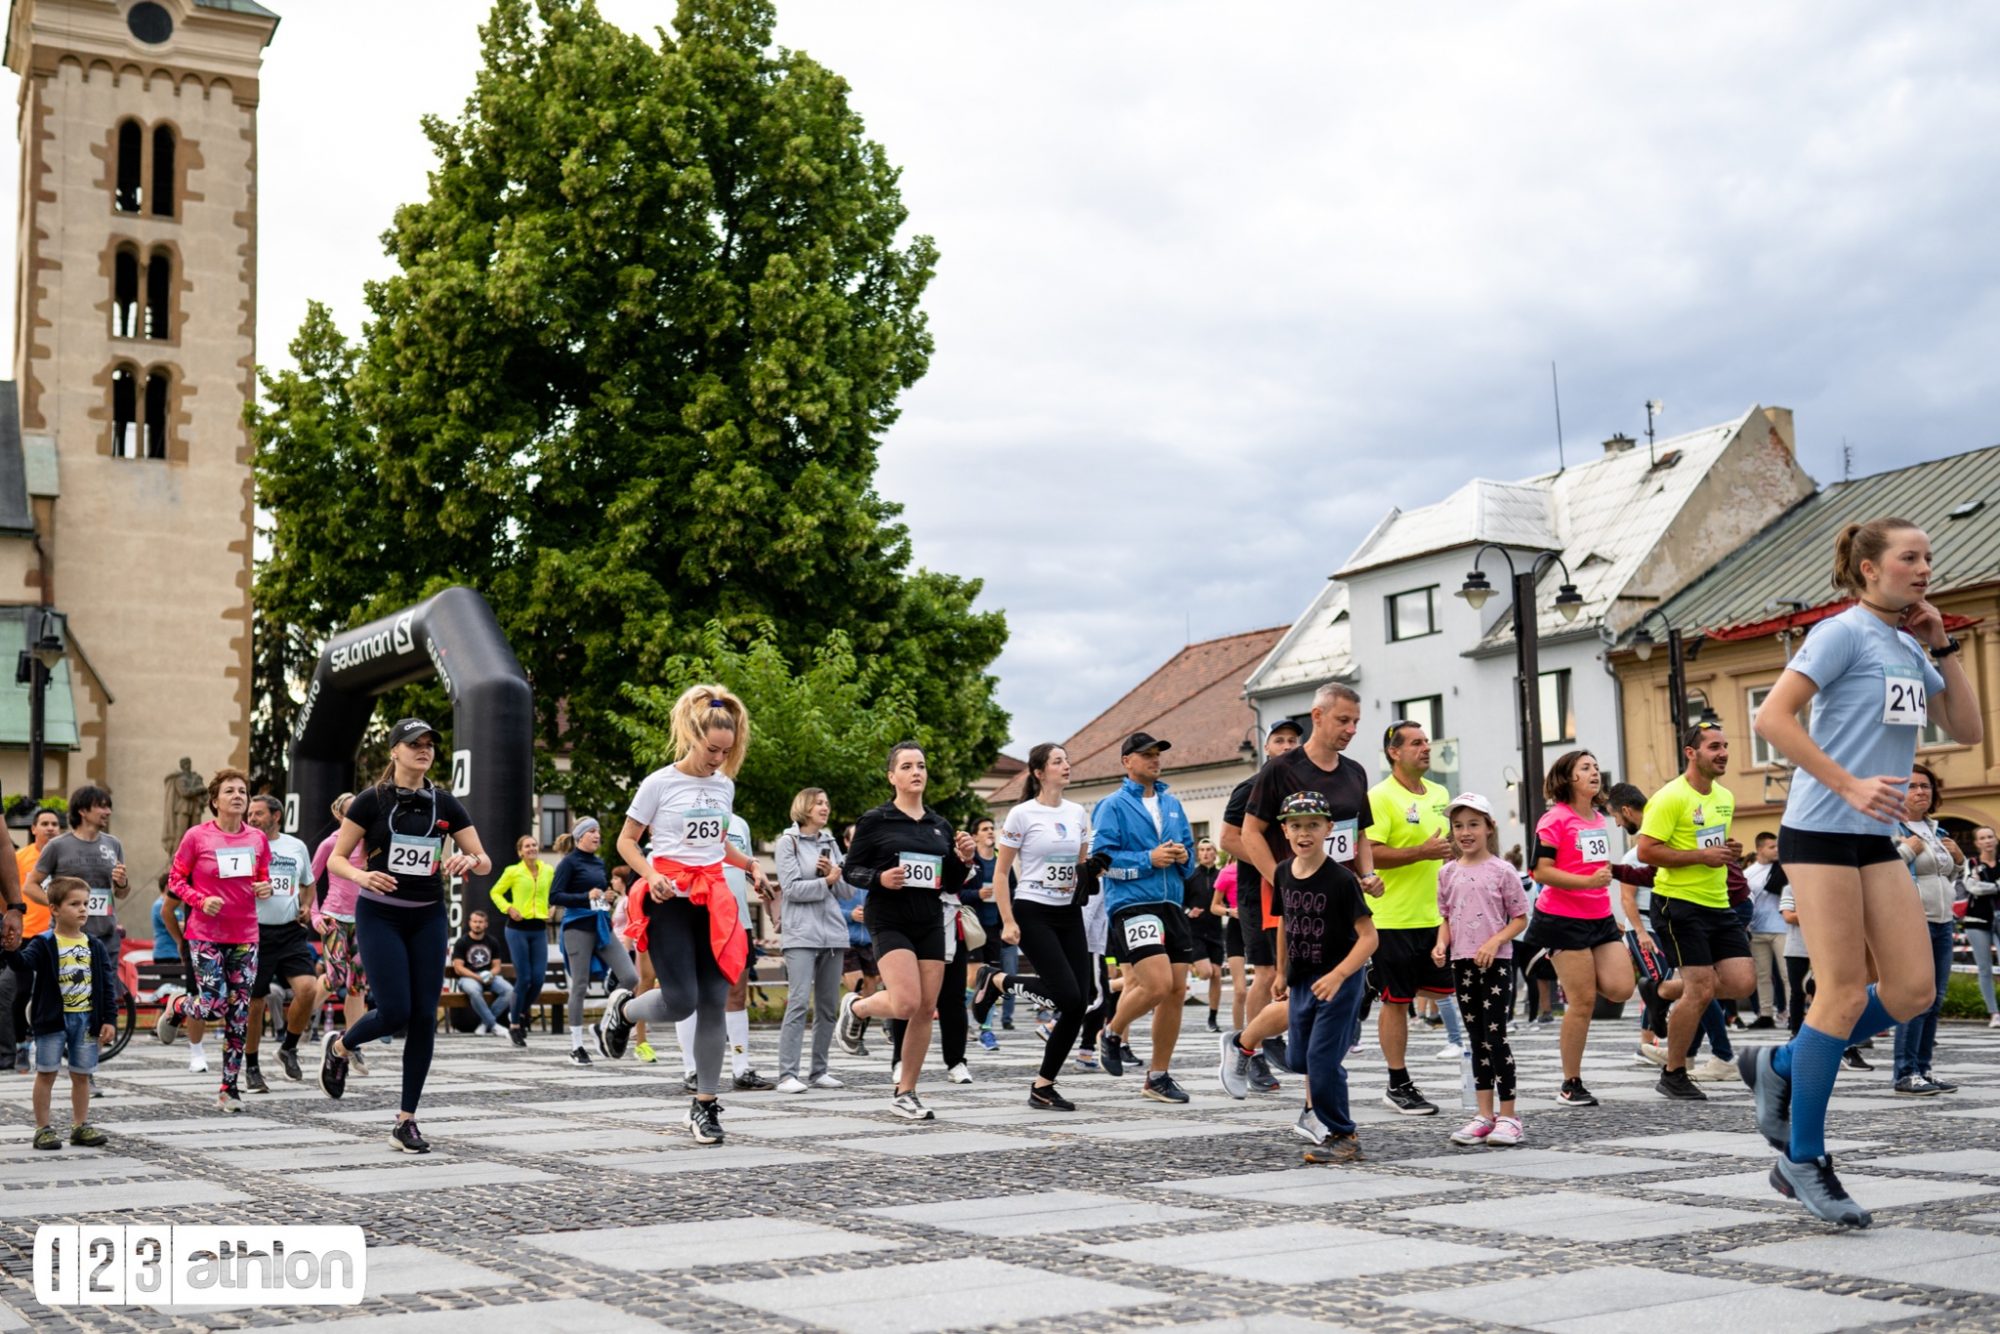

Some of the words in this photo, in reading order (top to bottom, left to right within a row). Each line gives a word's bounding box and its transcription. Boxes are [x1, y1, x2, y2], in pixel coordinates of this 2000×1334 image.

[331, 630, 392, 672] salomon
[427, 637, 451, 693] SUUNTO
[1890, 684, 1926, 714] 214
[295, 680, 320, 741] SUUNTO
[686, 820, 720, 839] 263
[1325, 835, 1347, 855] 78
[1589, 839, 1606, 855] 38
[230, 858, 240, 871] 7
[392, 847, 431, 868] 294
[902, 863, 933, 881] 360
[1046, 866, 1074, 881] 359
[269, 877, 289, 890] 38
[1128, 924, 1158, 943] 262
